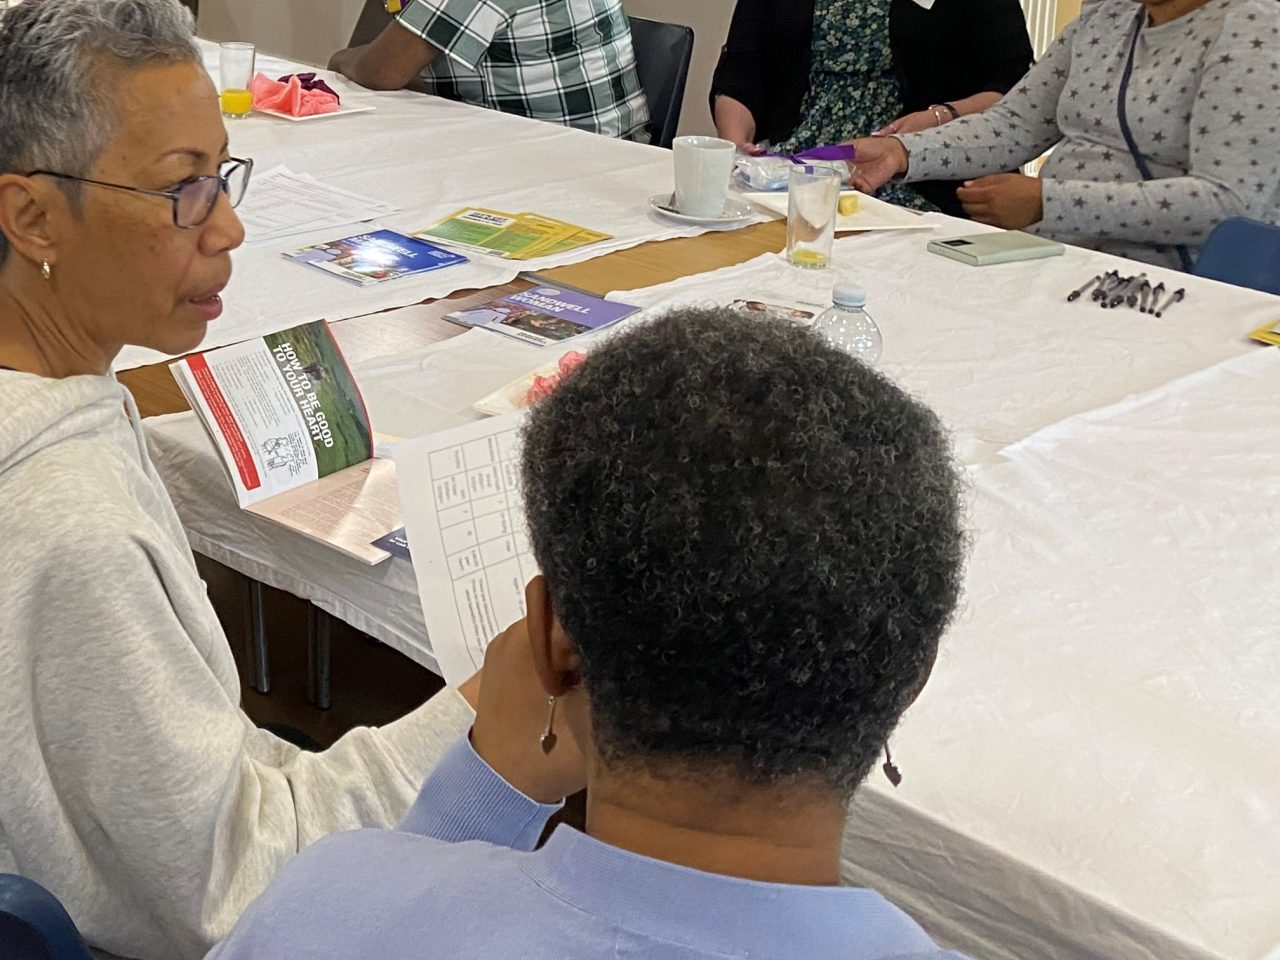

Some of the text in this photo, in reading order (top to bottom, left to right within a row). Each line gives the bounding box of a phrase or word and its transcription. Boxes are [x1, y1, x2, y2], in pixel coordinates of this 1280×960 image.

[509, 294, 566, 314] WOMAN
[519, 290, 592, 315] SANDWELL
[272, 344, 323, 441] TO YOUR HEART
[281, 342, 334, 448] HOW TO BE GOOD
